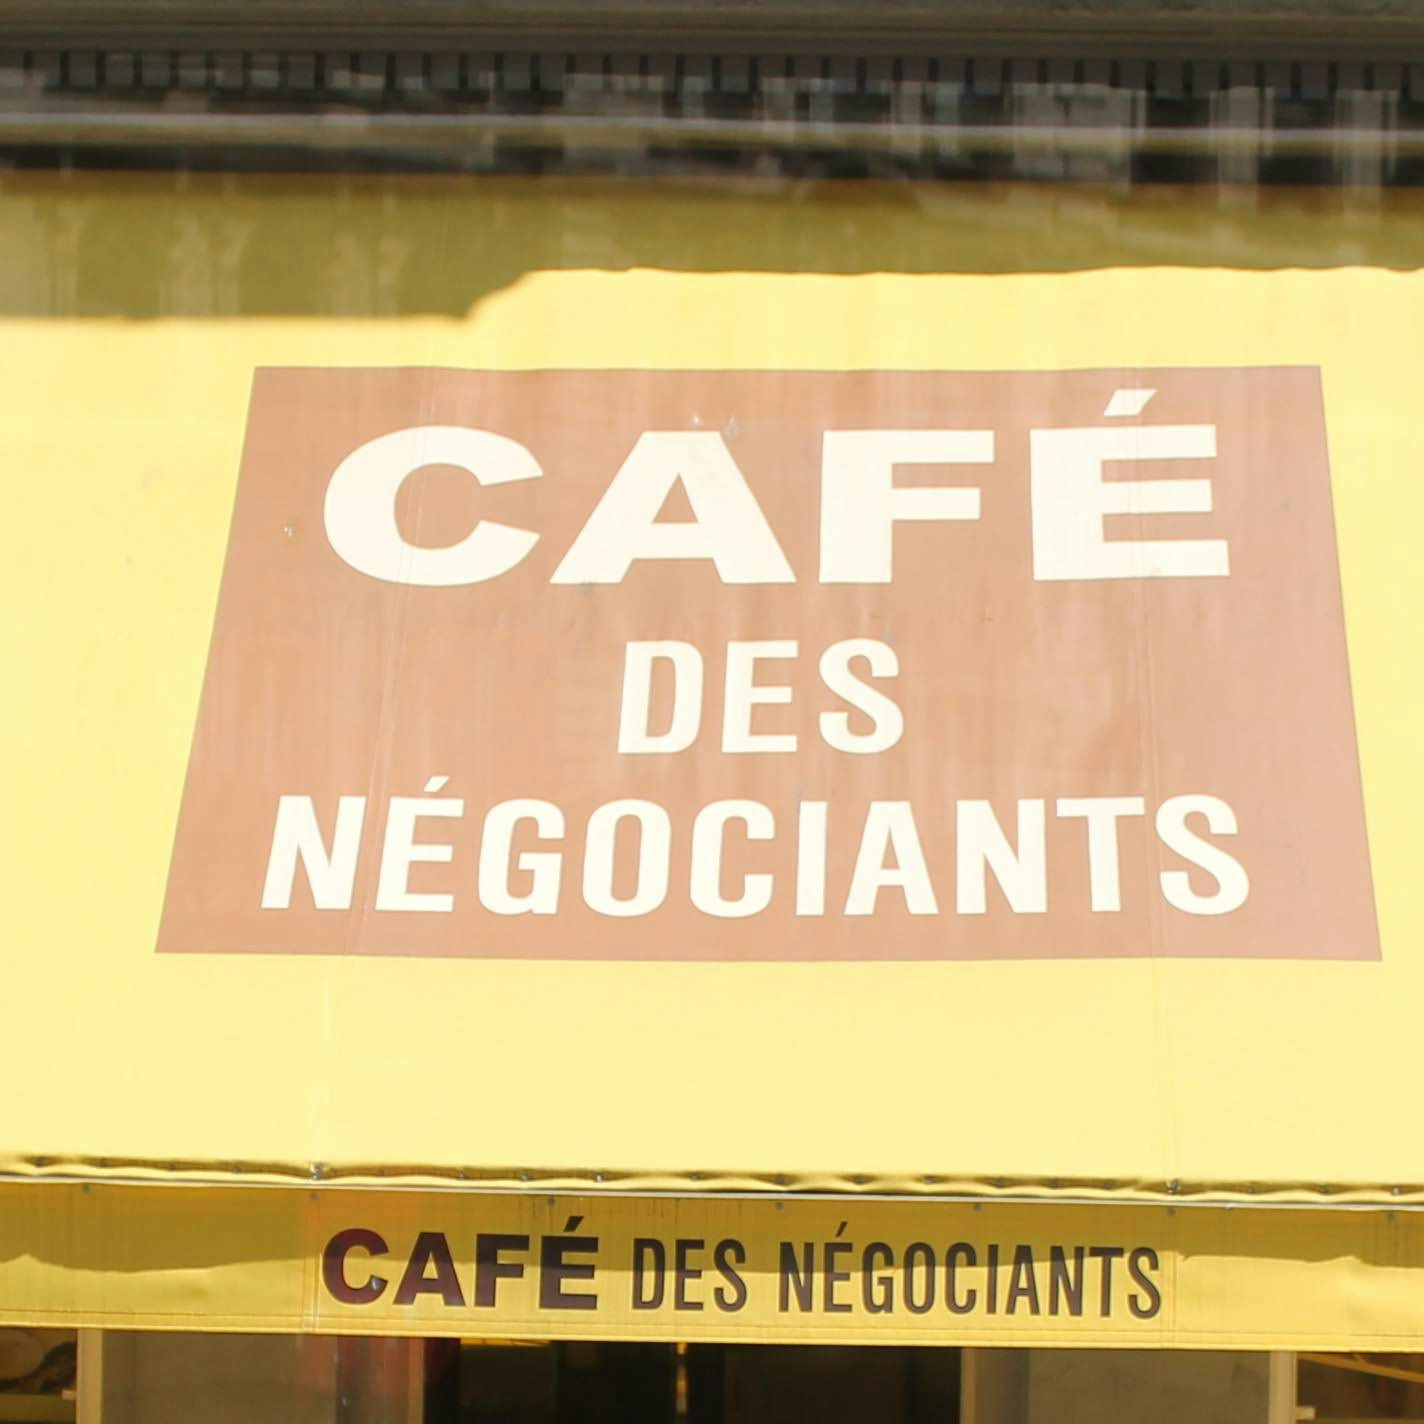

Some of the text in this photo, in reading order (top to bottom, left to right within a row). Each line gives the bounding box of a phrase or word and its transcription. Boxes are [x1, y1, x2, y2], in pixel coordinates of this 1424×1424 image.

[323, 388, 1231, 587] CAFÉ
[617, 637, 906, 754] DES
[260, 775, 1251, 917] NÉGOCIANTS
[320, 1215, 1163, 1320] CAFÉ DES NÉGOCIANTS
